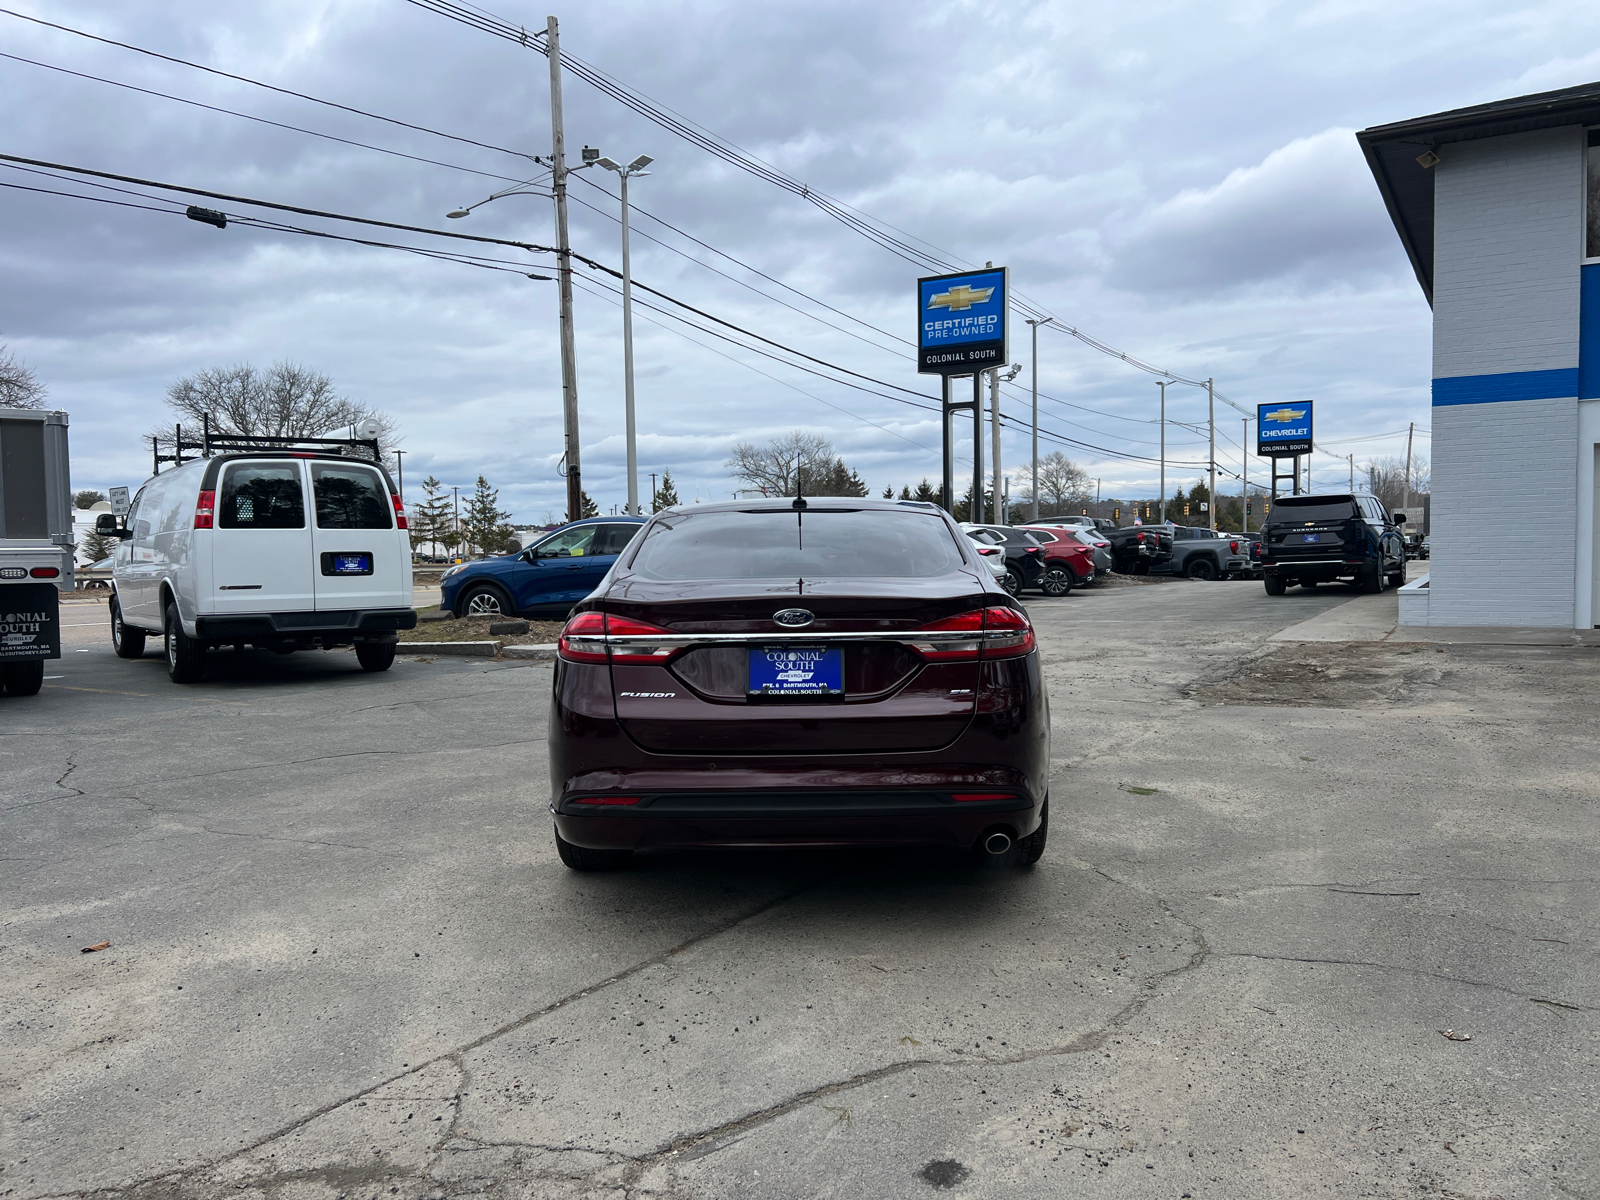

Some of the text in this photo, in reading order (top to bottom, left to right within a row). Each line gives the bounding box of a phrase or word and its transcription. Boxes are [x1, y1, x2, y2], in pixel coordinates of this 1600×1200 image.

[924, 315, 997, 331] CERTIFIED
[928, 324, 994, 339] PRE-OWNED
[926, 349, 996, 363] COLONIAL SOUTH
[1262, 428, 1308, 437] CHEVROLET
[782, 612, 806, 622] Ford
[766, 652, 823, 661] COLONIAL
[775, 662, 814, 670] SOUTH
